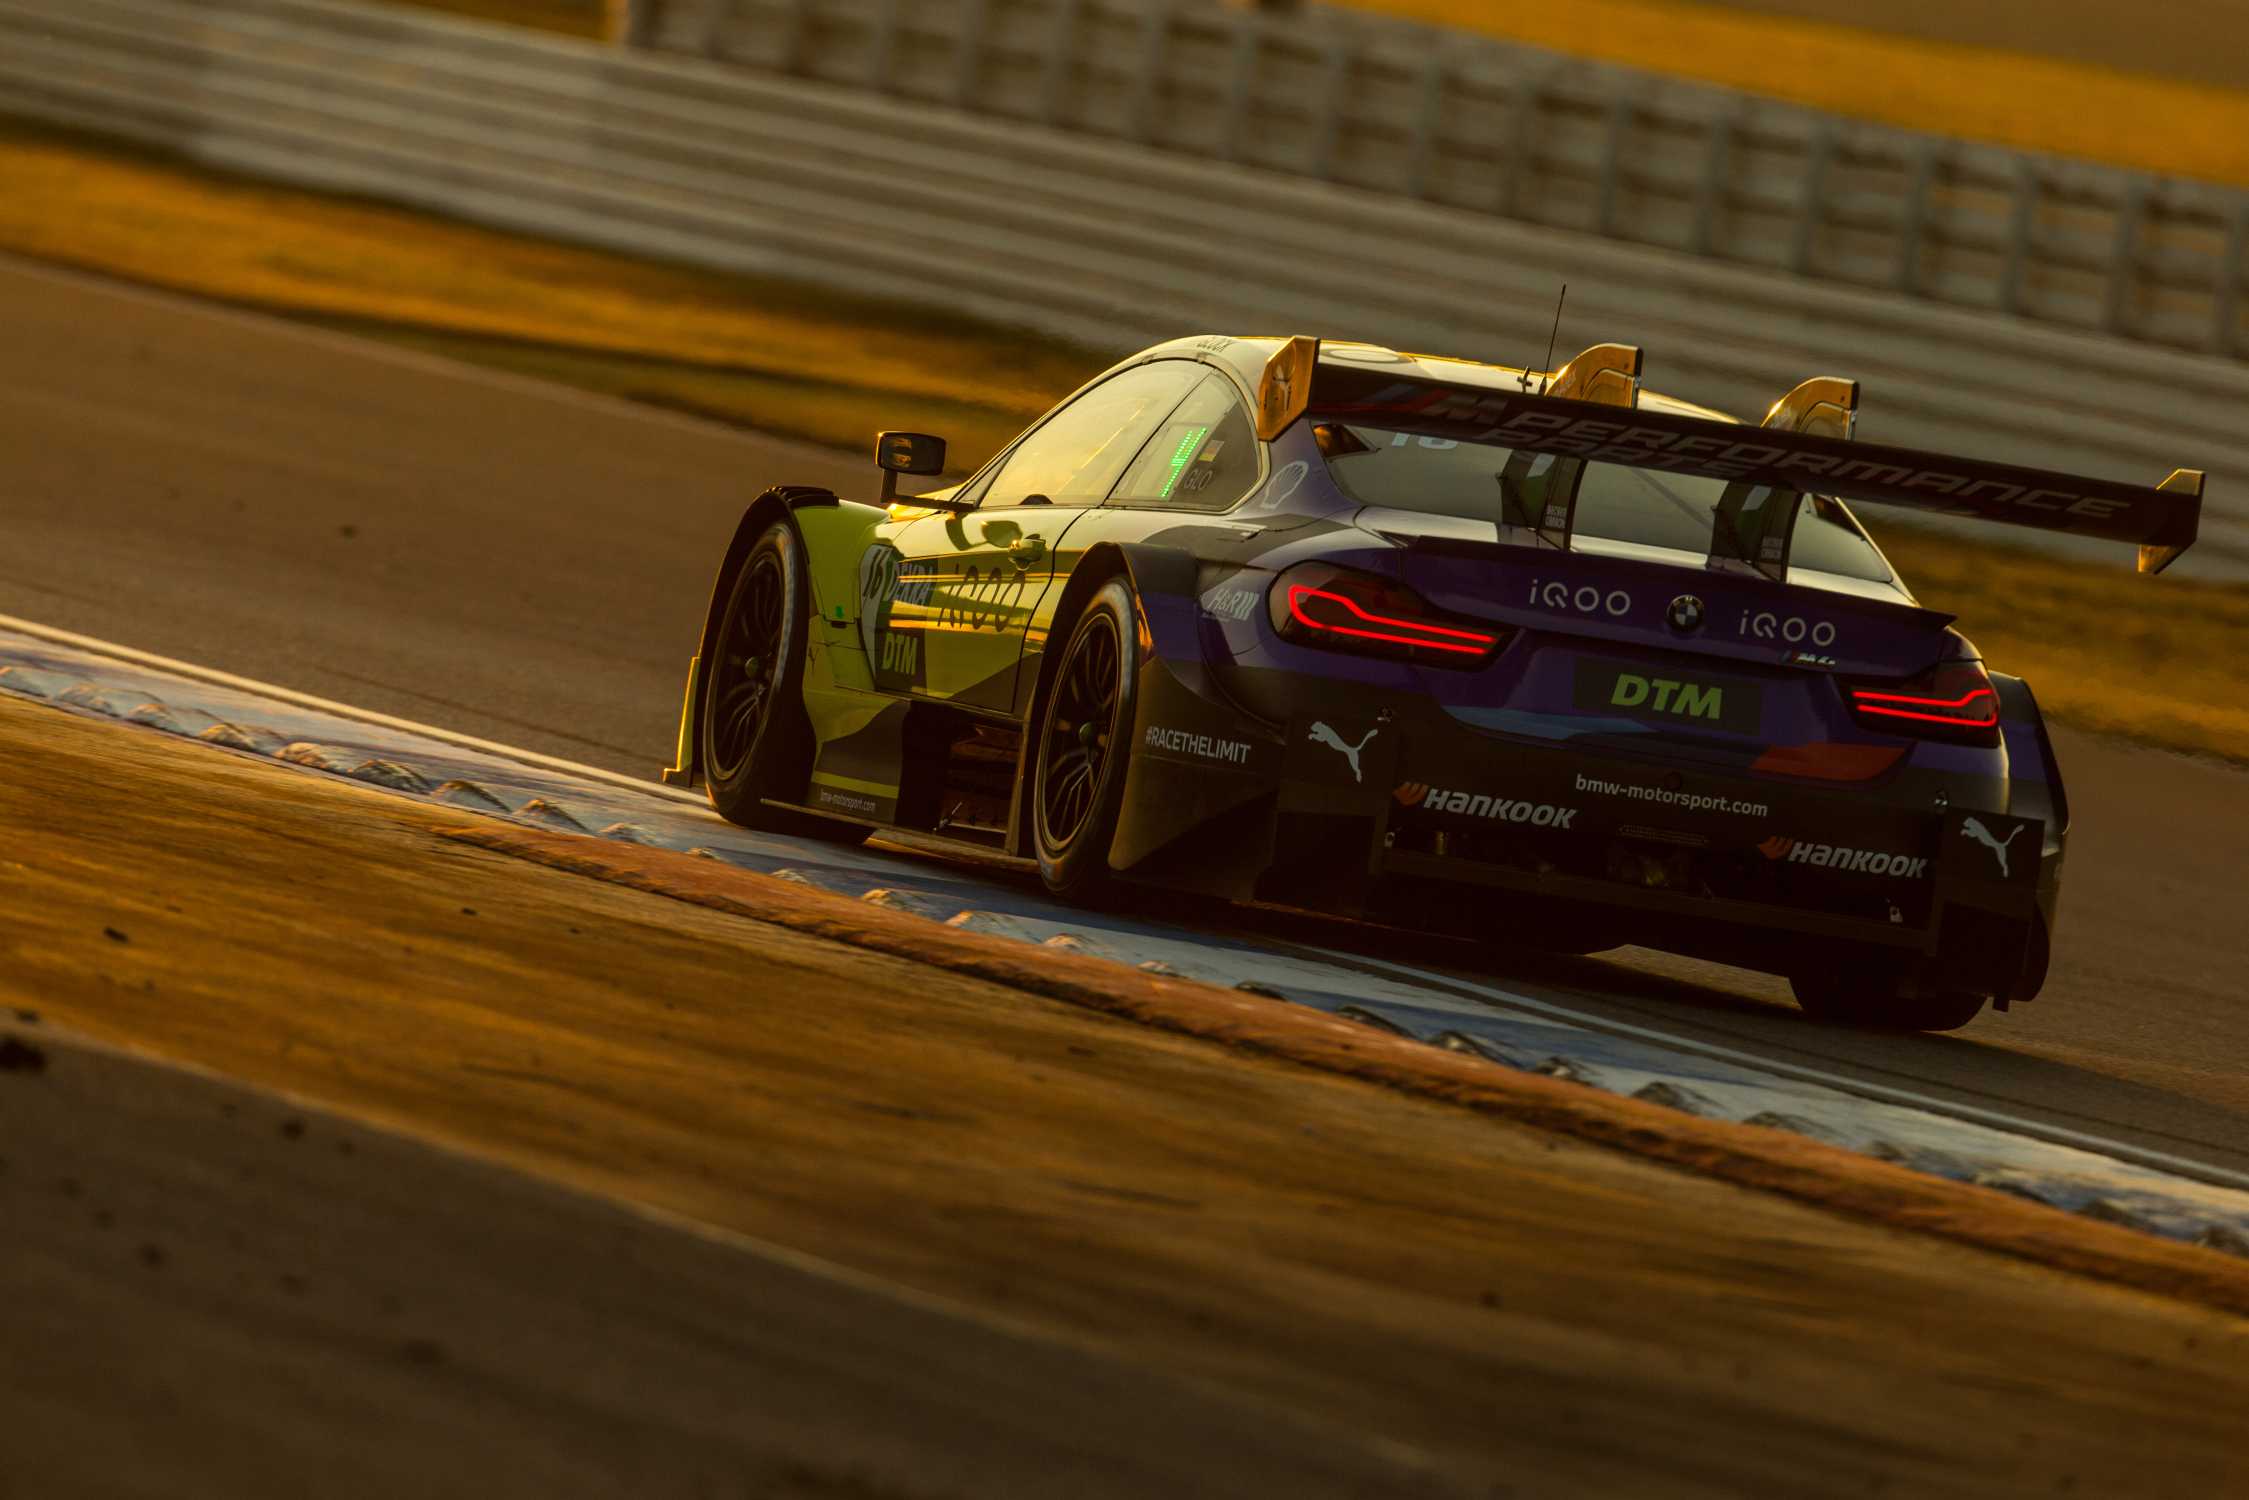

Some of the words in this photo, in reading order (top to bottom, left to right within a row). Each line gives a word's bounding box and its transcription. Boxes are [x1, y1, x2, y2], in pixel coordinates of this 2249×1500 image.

[1500, 411, 2132, 519] PERFORMANCE
[1529, 578, 1632, 617] iQOO
[1739, 608, 1837, 648] iQOO
[880, 631, 919, 677] DTM
[1610, 671, 1724, 721] DTM
[1145, 725, 1253, 765] #RACETHELIMIT
[1575, 773, 1770, 818] bmw-motorsport.com
